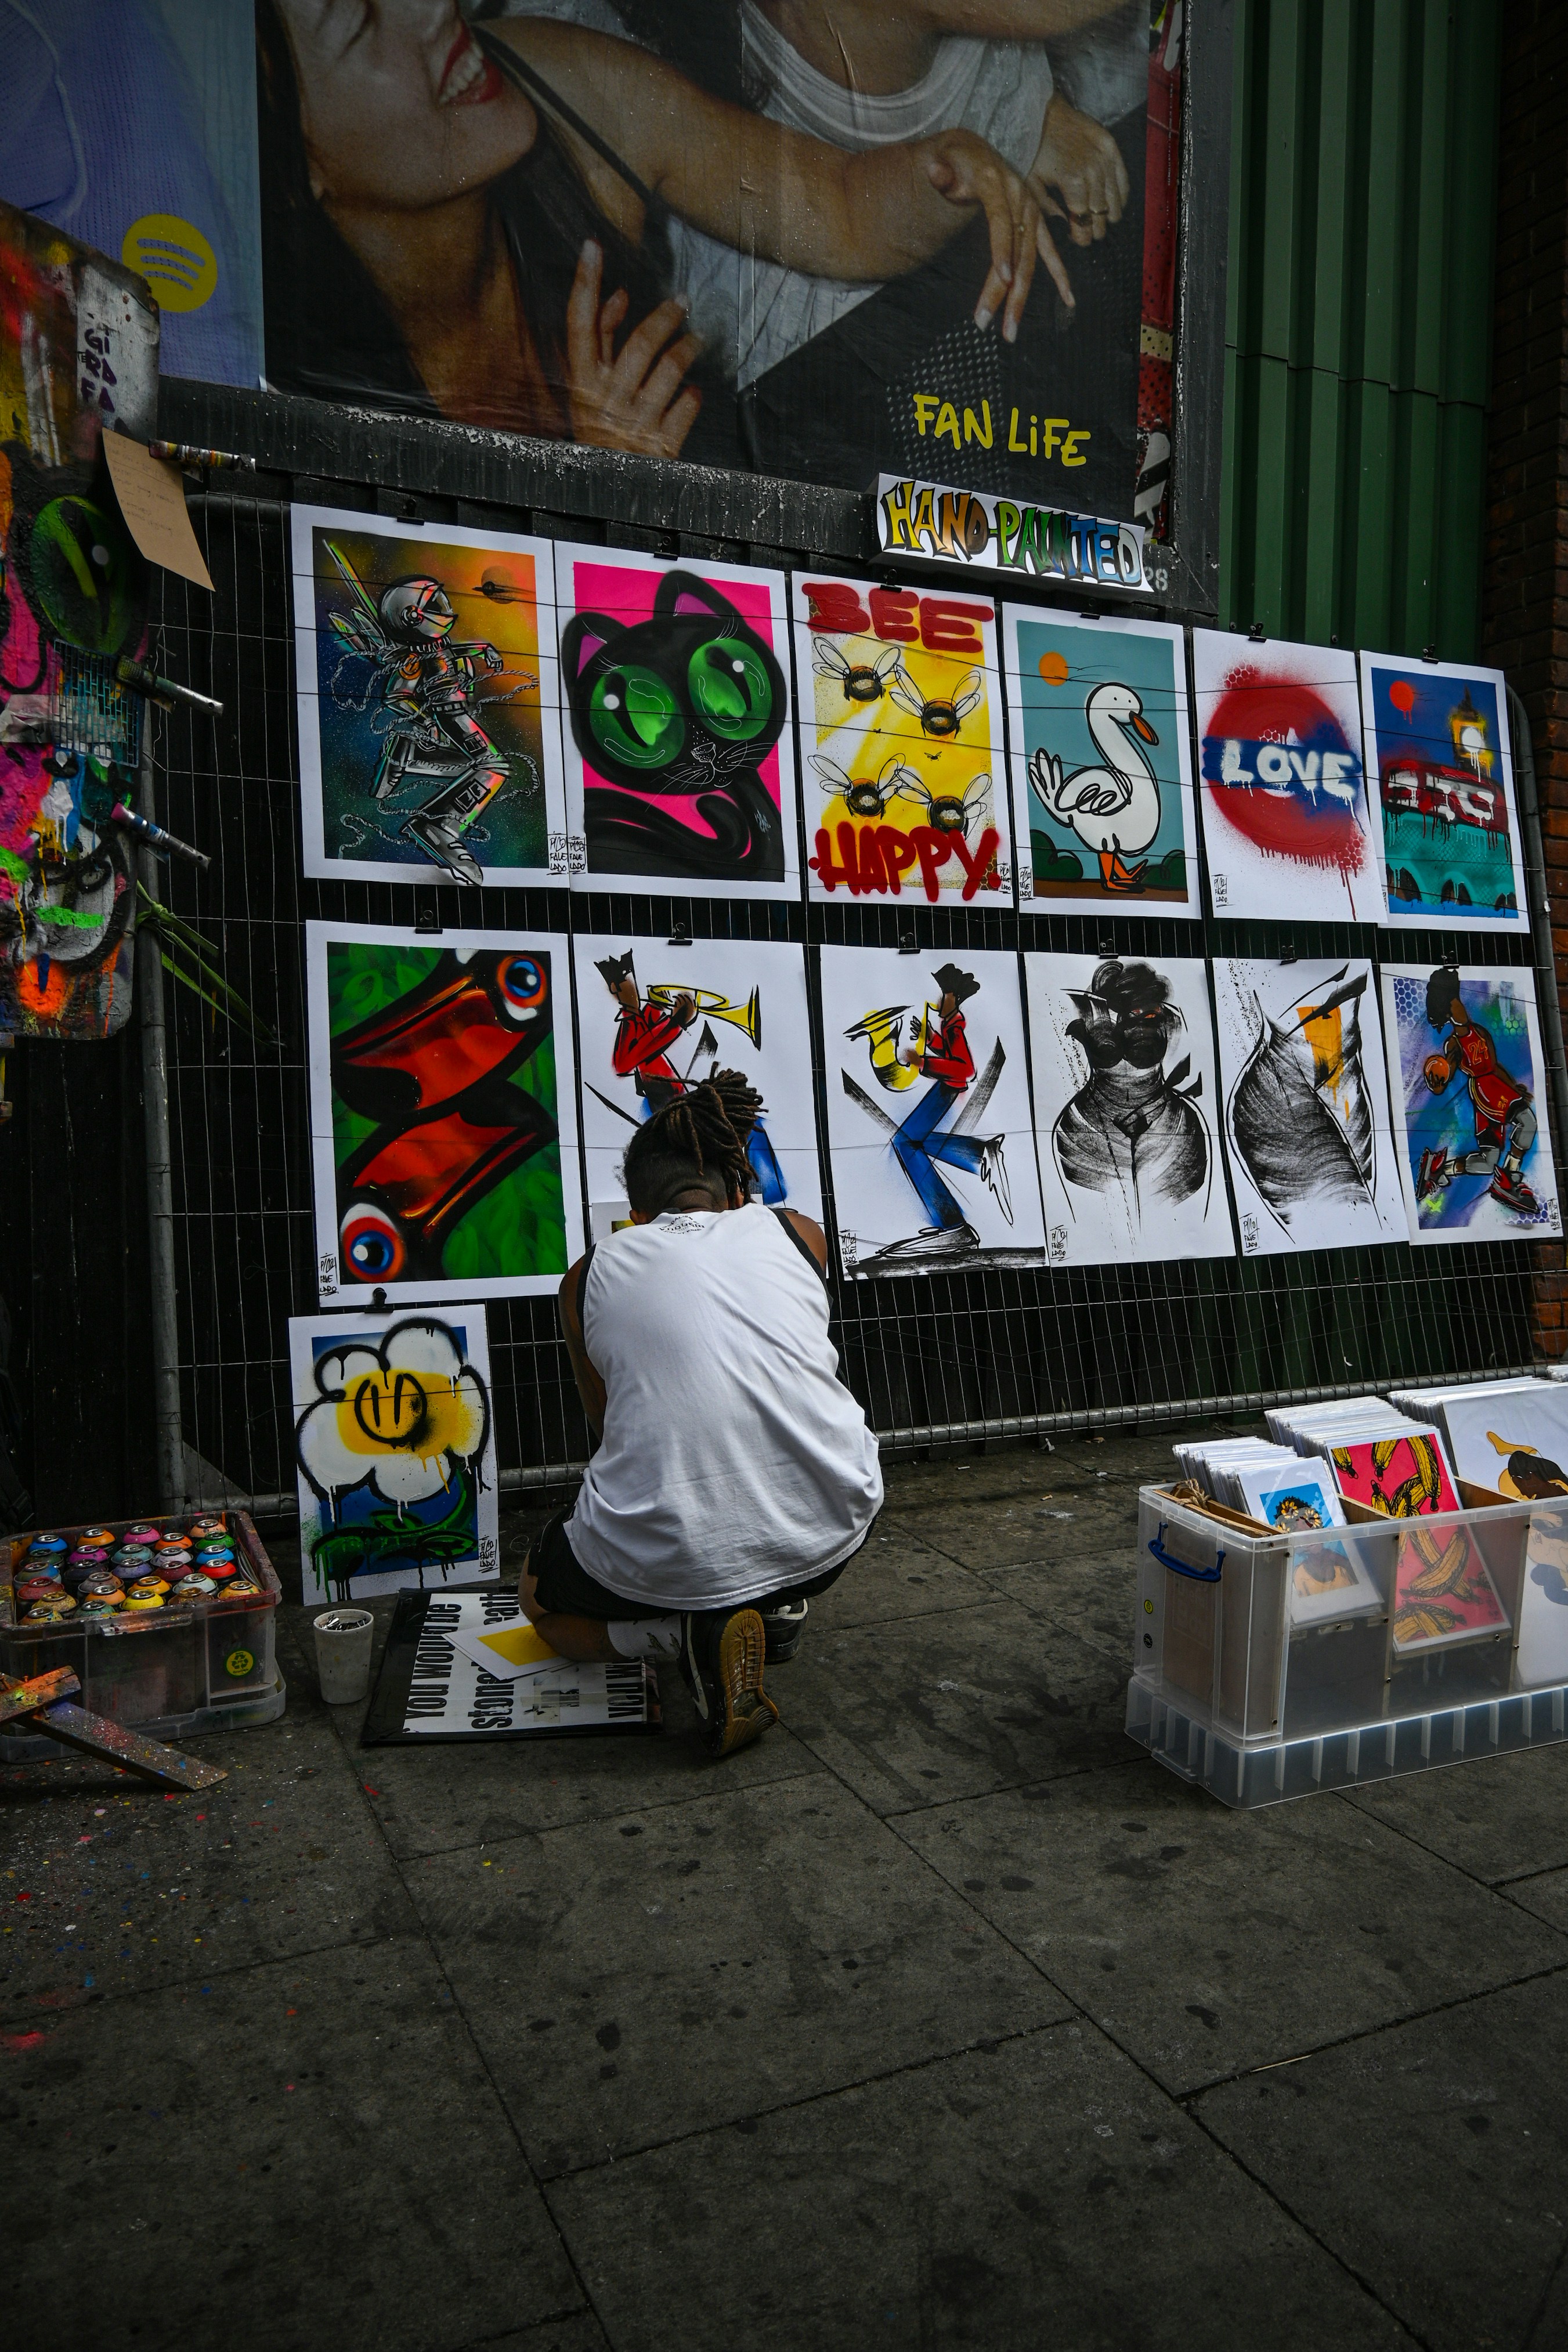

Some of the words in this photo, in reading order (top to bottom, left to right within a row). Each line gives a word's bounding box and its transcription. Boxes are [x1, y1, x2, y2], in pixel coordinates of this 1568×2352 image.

[912, 393, 993, 450] FAN
[879, 480, 1143, 587] HAND-PAINTED
[801, 583, 995, 653] BEE
[1220, 739, 1356, 801] LOVE
[1468, 1039, 1488, 1065] 24
[480, 1593, 519, 1625] eath
[468, 1662, 514, 1729] stone
